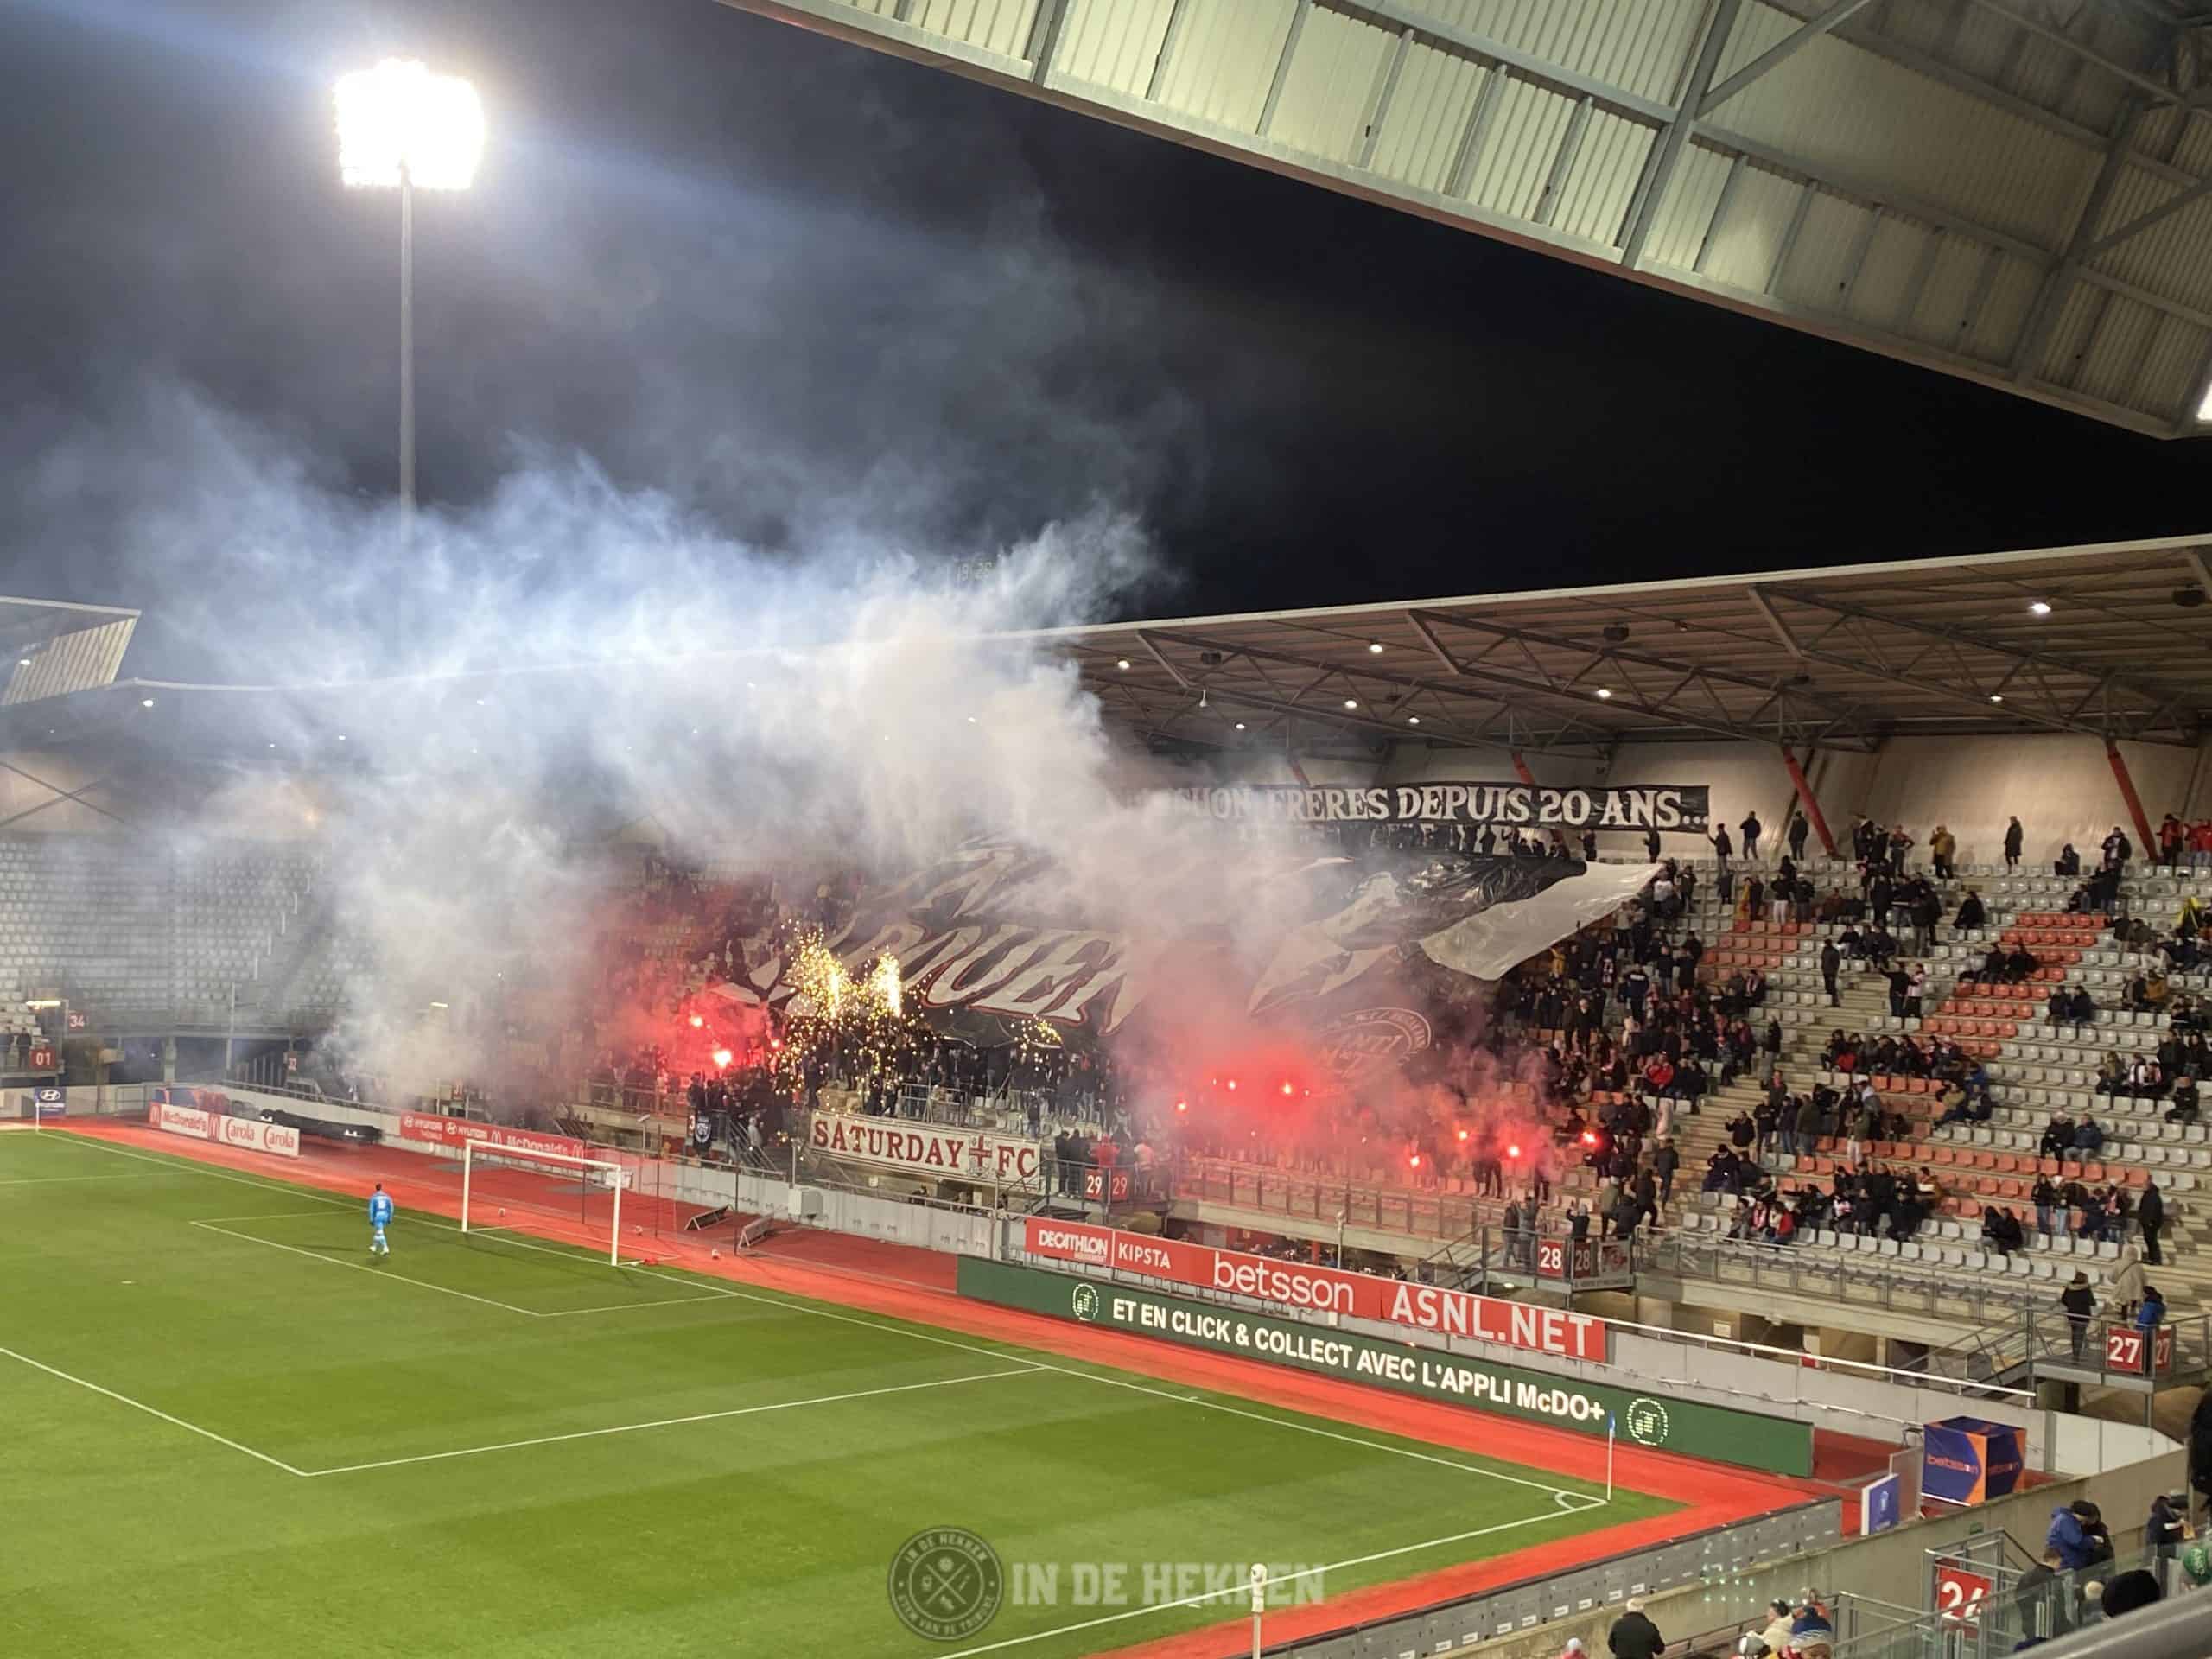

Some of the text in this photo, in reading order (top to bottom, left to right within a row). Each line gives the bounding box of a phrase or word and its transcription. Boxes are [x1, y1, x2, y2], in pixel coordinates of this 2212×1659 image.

[1267, 787, 1390, 821] FRERES
[1396, 785, 1532, 822] DEPUIS
[1539, 789, 1592, 823] 20
[1599, 789, 1709, 828] ANS...
[69, 1014, 85, 1028] 34
[35, 1052, 52, 1065] 01
[226, 1118, 256, 1141] Carola
[264, 1125, 296, 1149] Carola
[814, 1120, 1036, 1178] SATURDAY FC
[1086, 1174, 1103, 1195] 29
[1112, 1176, 1128, 1196] 29
[1540, 1246, 1563, 1270] 28
[1575, 1249, 1591, 1271] 28
[1039, 1230, 1594, 1357] DECATHLON KIPSTA betsson ASNL.NET
[1112, 1298, 1605, 1421] ET EN CLICK & COLLECT AVEC L'APPLI McDO+
[2108, 1336, 2141, 1364] 27
[2156, 1338, 2171, 1365] 27
